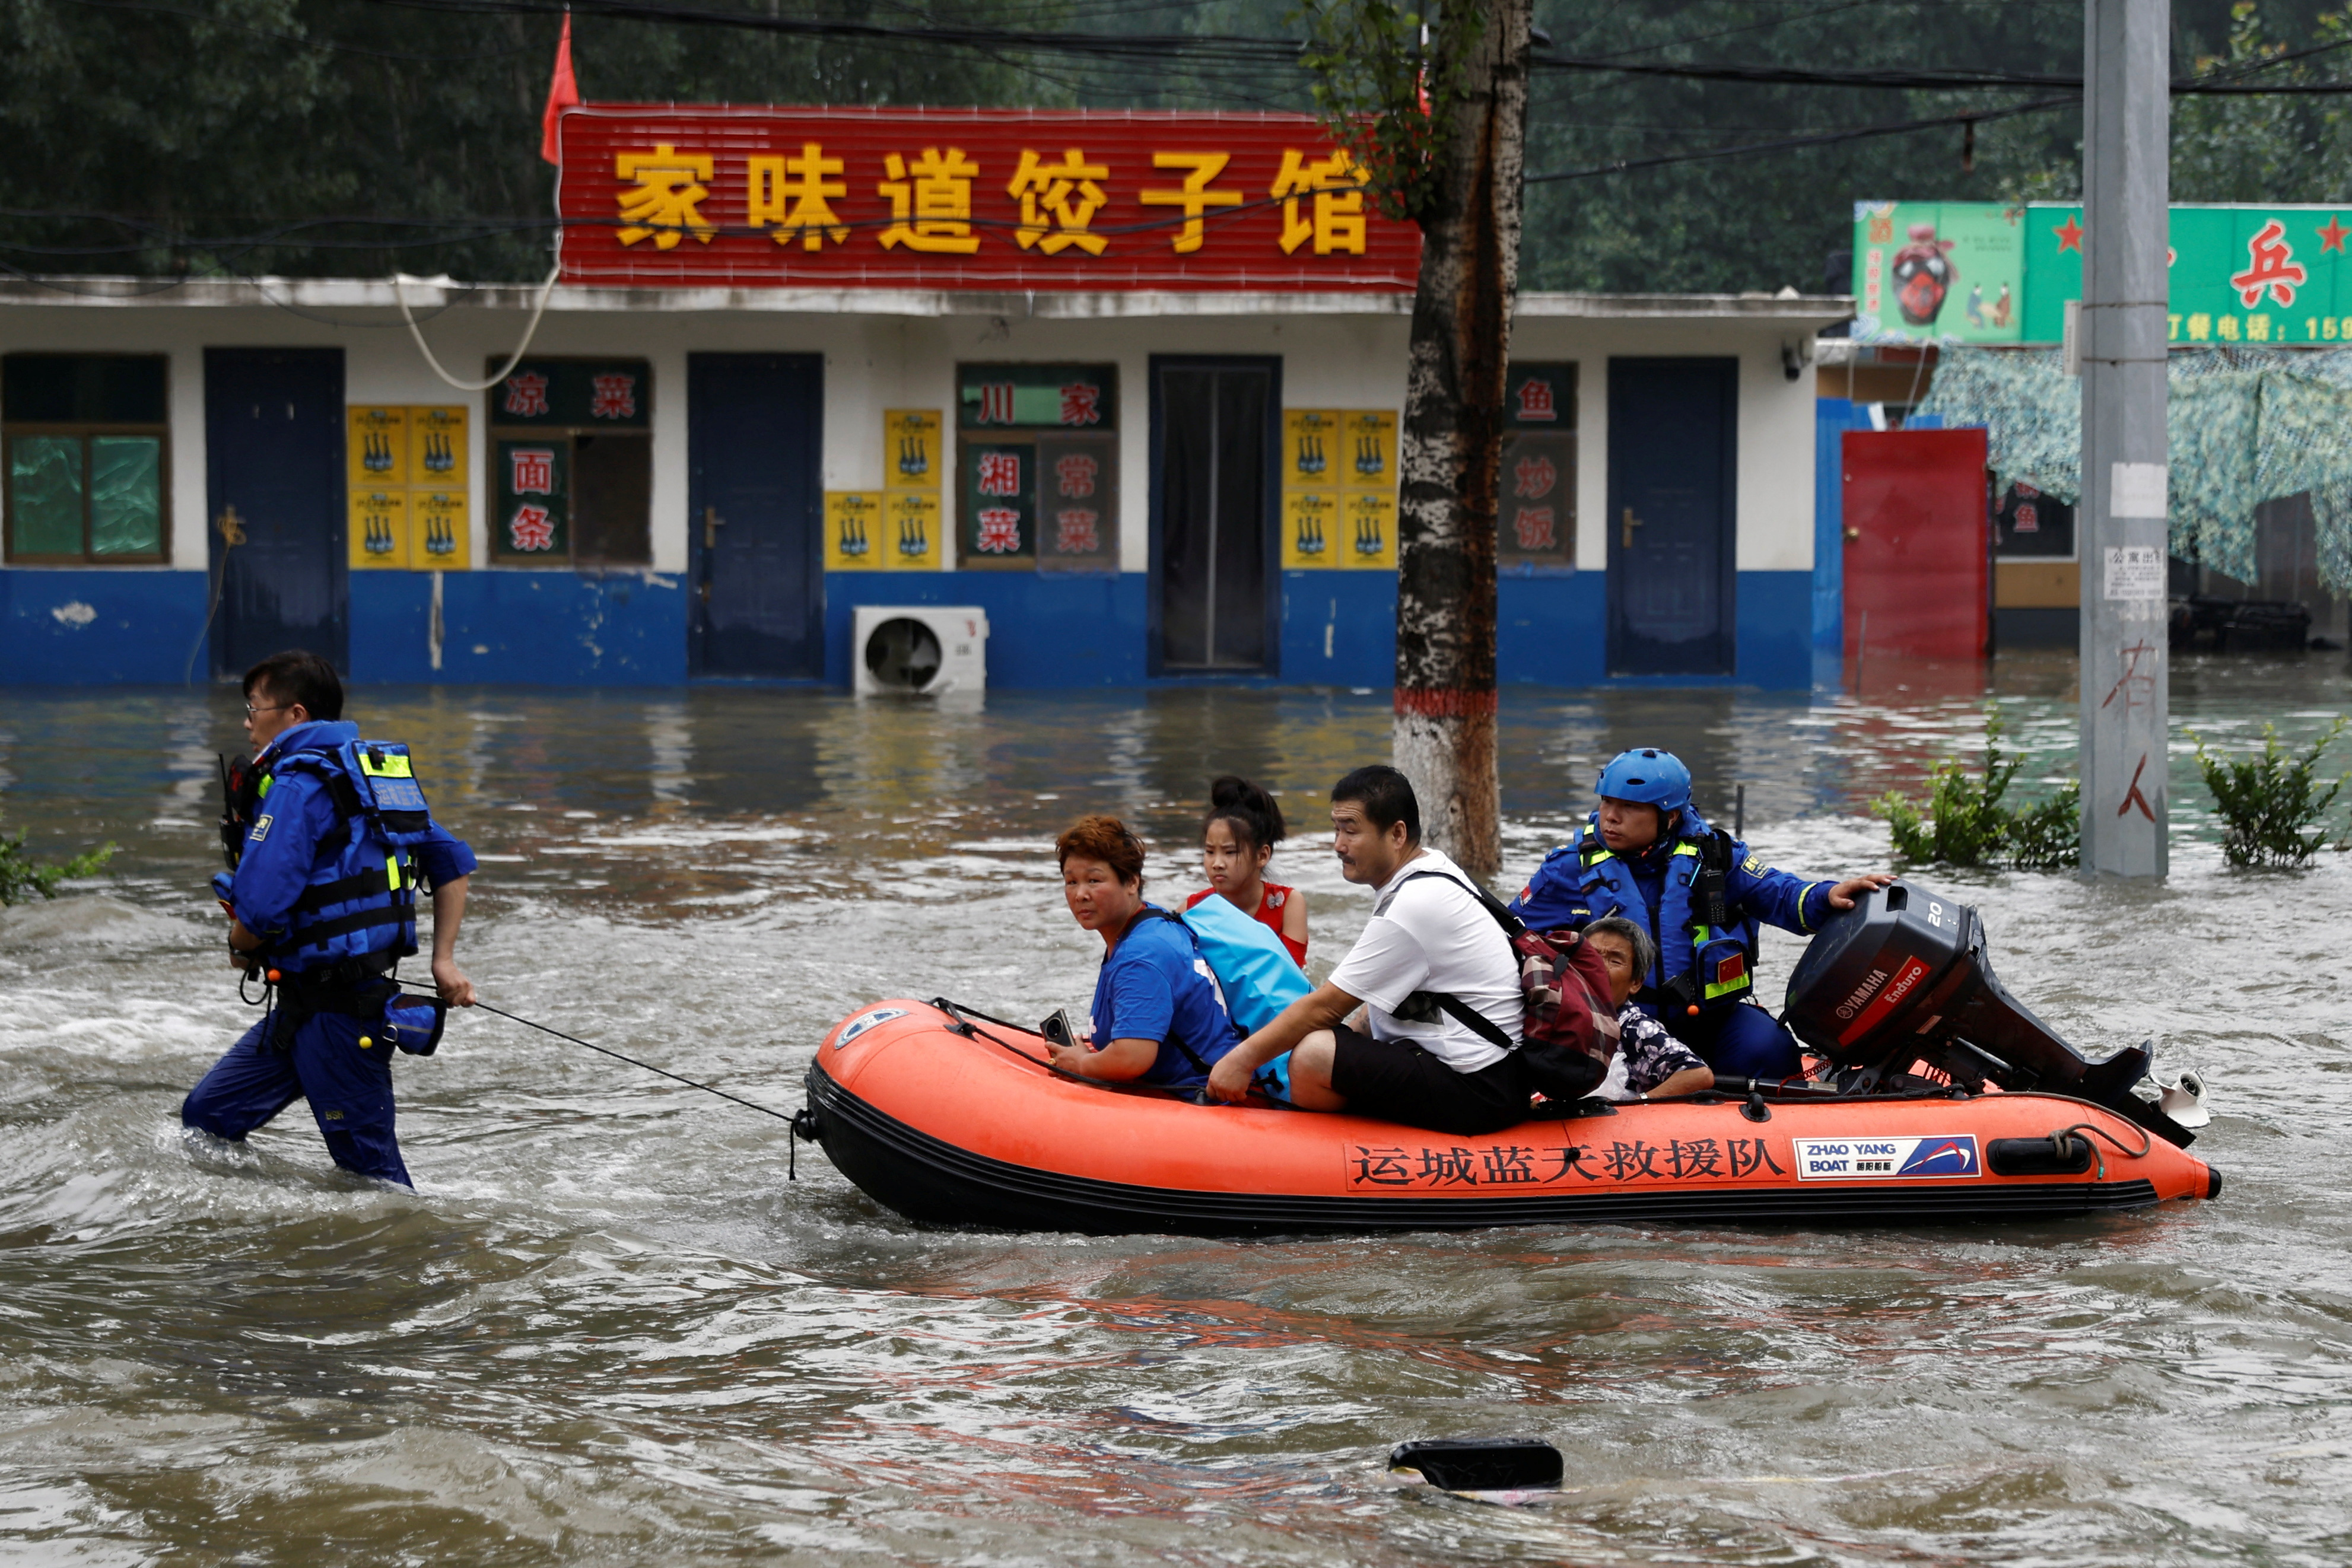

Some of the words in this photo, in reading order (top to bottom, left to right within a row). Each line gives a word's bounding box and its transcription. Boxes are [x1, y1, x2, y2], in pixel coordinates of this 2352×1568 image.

[615, 142, 1371, 255] 家味道饺子馆
[505, 374, 635, 418] 凉菜
[1517, 379, 1557, 422] 鱼
[509, 448, 555, 551] 面条
[1514, 456, 1557, 549] 炒饭
[2101, 638, 2158, 823] 有人
[1928, 902, 1942, 928] 20
[1845, 969, 1888, 1010] YAMAHA
[1884, 966, 1922, 1004] Enduro
[1351, 1138, 1787, 1187] 运城蓝天救援队
[1807, 1144, 1849, 1156] ZHAO
[1854, 1143, 1896, 1154] YANG
[1810, 1160, 1850, 1172] BOAT
